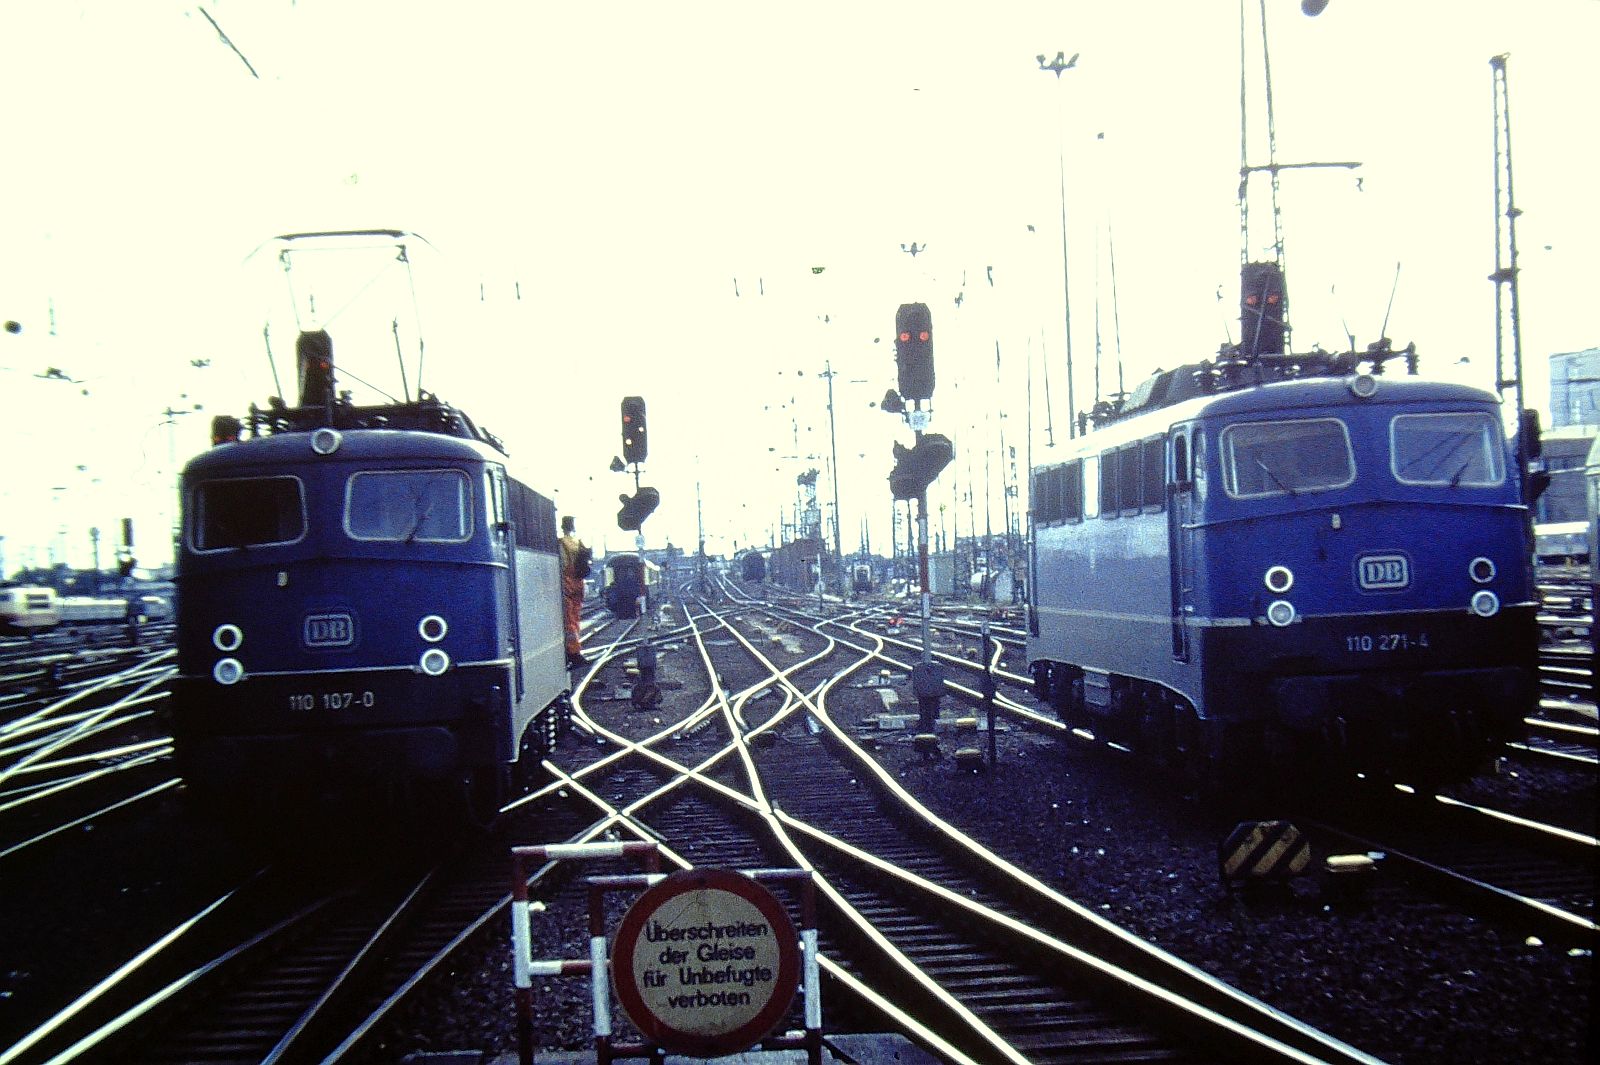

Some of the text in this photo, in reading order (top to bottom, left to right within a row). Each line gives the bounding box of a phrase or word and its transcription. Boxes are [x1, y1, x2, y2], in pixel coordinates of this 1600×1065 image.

[1365, 561, 1402, 582] DB
[310, 619, 347, 641] DB
[1346, 633, 1429, 651] 110 271-4
[289, 691, 375, 710] 110 107-0
[645, 921, 769, 942] Überschreiten
[659, 942, 755, 964] der Gleise
[643, 965, 772, 987] für Unbefugte
[668, 989, 751, 1008] verboten
